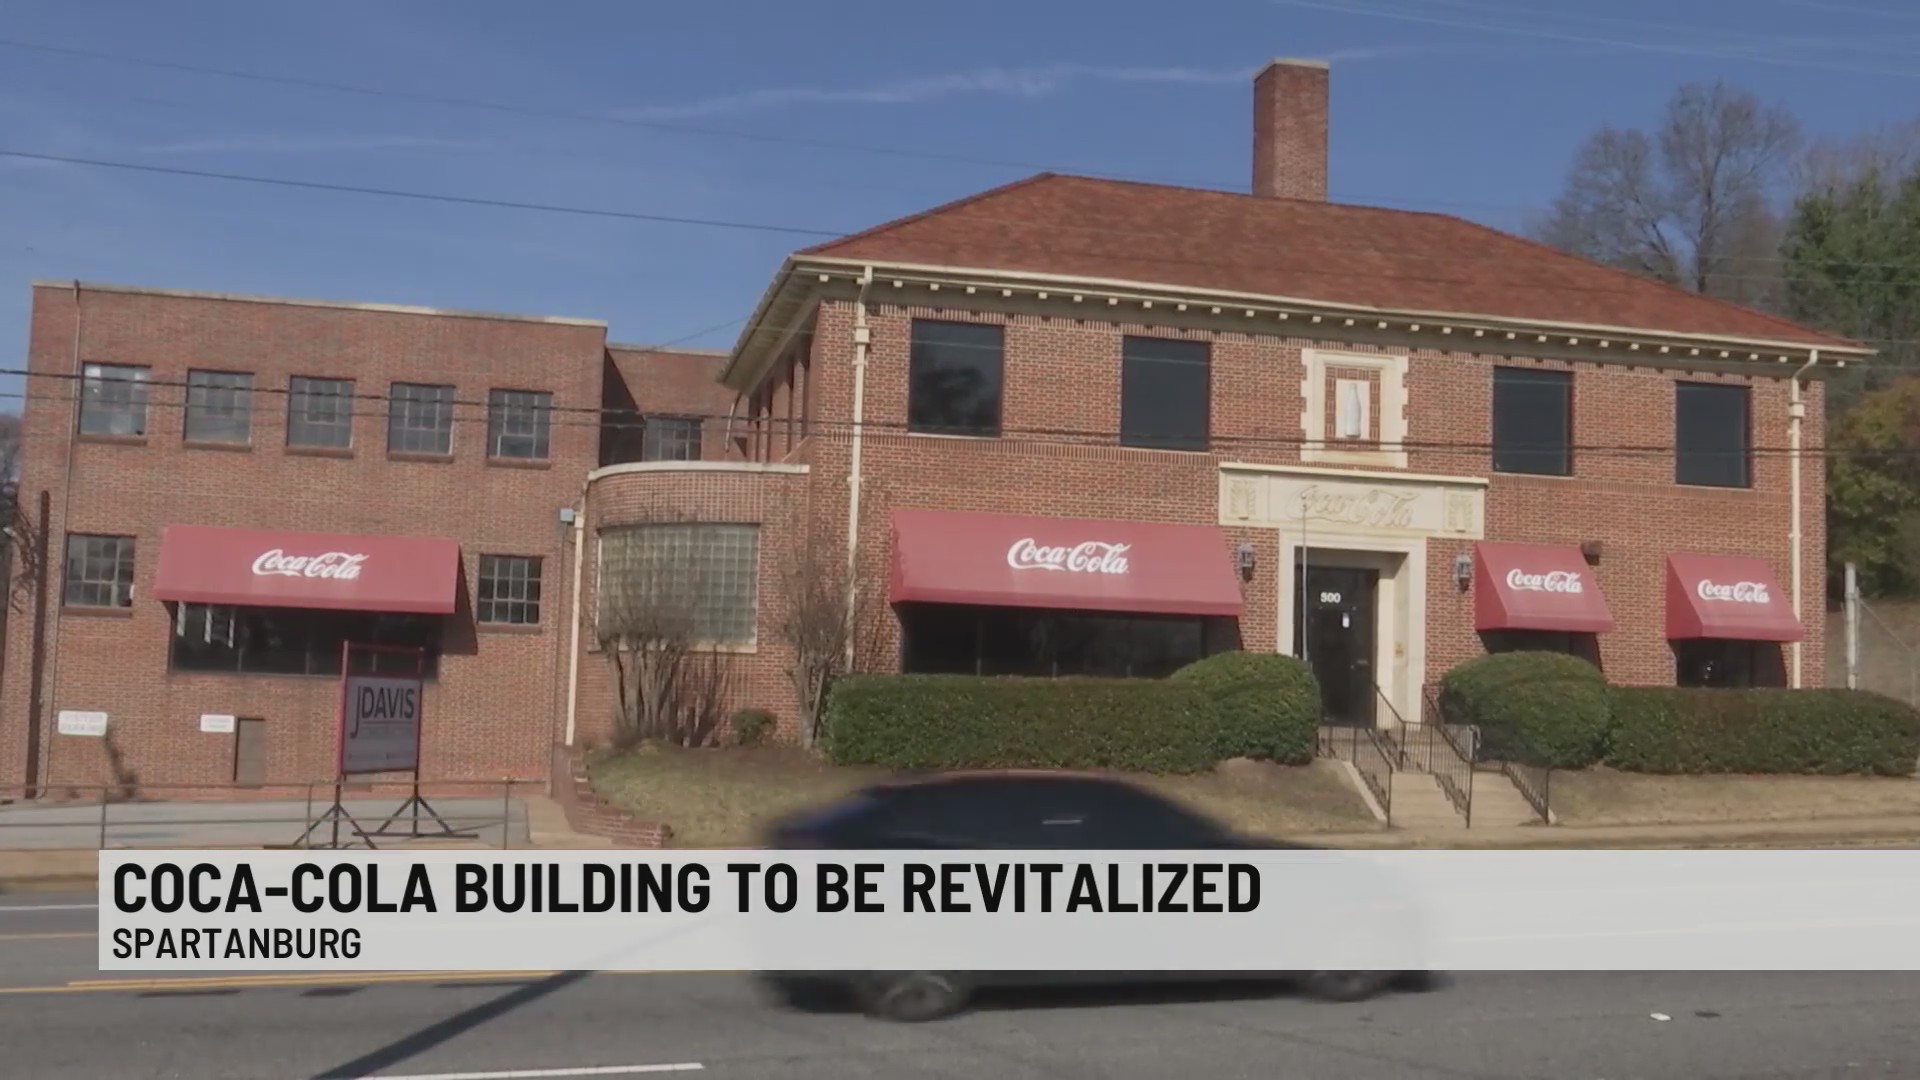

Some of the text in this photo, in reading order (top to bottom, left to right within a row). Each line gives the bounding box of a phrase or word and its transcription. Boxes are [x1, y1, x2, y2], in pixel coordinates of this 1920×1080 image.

[252, 549, 369, 579] Coca-Cola
[1007, 538, 1131, 574] Coca-Cola
[1507, 568, 1582, 593] Coca-Cola
[1697, 579, 1770, 603] Coca-Cola
[1320, 592, 1341, 604] 500
